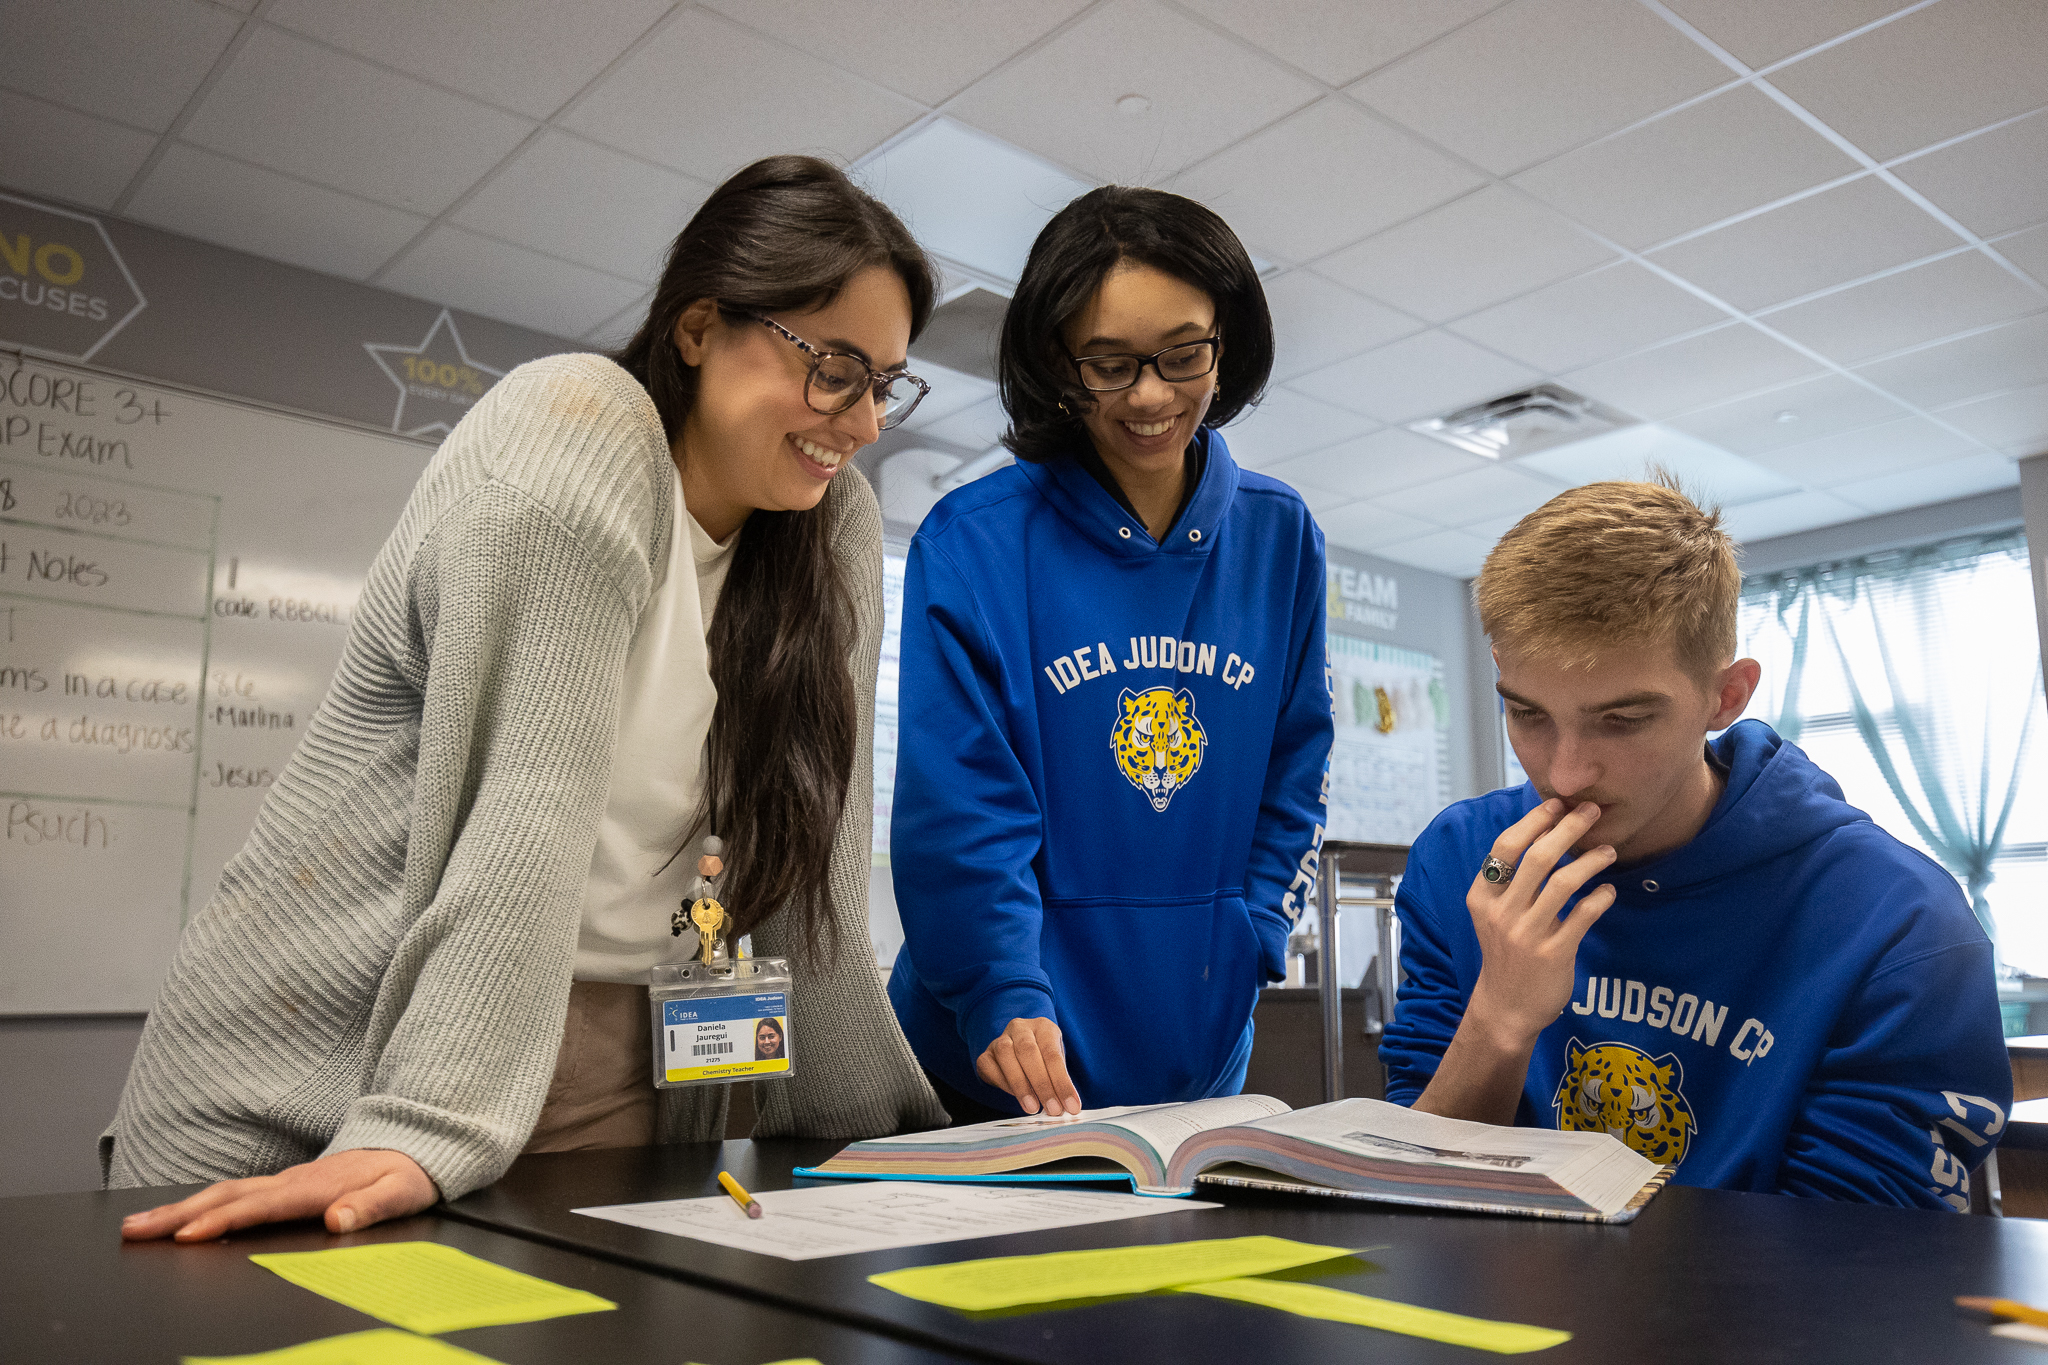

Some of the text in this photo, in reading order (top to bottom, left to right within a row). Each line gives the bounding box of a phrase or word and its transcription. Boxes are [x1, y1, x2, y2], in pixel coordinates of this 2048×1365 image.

[0, 232, 84, 286] NO
[403, 356, 482, 396] 100%
[37, 423, 134, 470] Exam
[55, 490, 132, 527] 2023
[1326, 562, 1398, 611] TEAM
[64, 673, 89, 698] in
[96, 676, 117, 699] a
[1044, 642, 1117, 695] IDEA
[1221, 652, 1255, 691] CP
[40, 717, 58, 742] a
[68, 714, 195, 754] diagnosis
[696, 1032, 728, 1043] Jauregui
[697, 1023, 726, 1032] Daniela
[1571, 976, 1775, 1067] JUDSON CP
[702, 1065, 755, 1077] Chemistry Teacher
